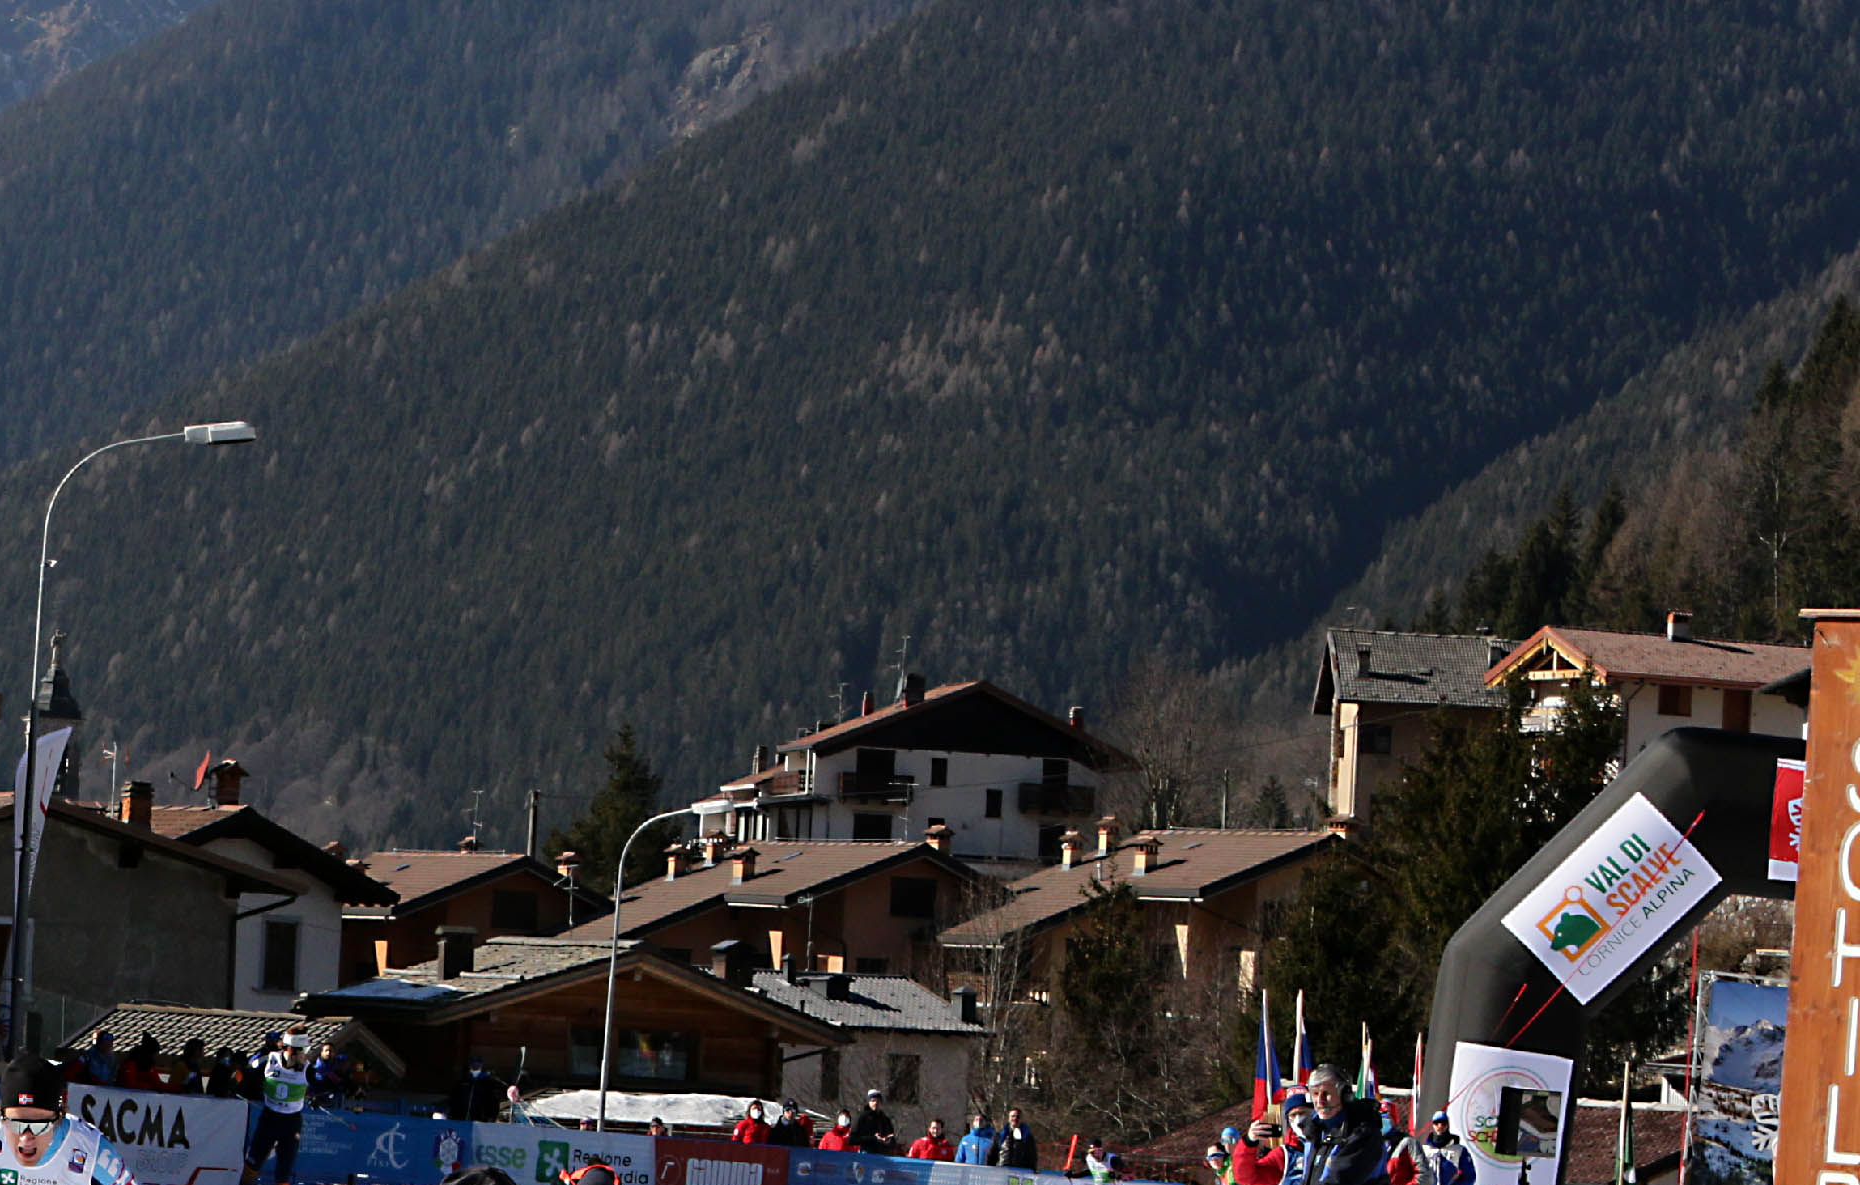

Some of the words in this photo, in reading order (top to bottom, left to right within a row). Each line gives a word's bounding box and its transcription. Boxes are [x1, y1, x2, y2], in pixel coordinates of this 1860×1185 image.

[1585, 856, 1629, 894] VAL
[1620, 833, 1651, 863] DI
[1606, 843, 1683, 916] SCALVE
[1578, 915, 1642, 976] CORNICE
[1642, 868, 1696, 919] ALPINA
[81, 1094, 190, 1150] SACMA
[19, 1174, 58, 1185] Regione
